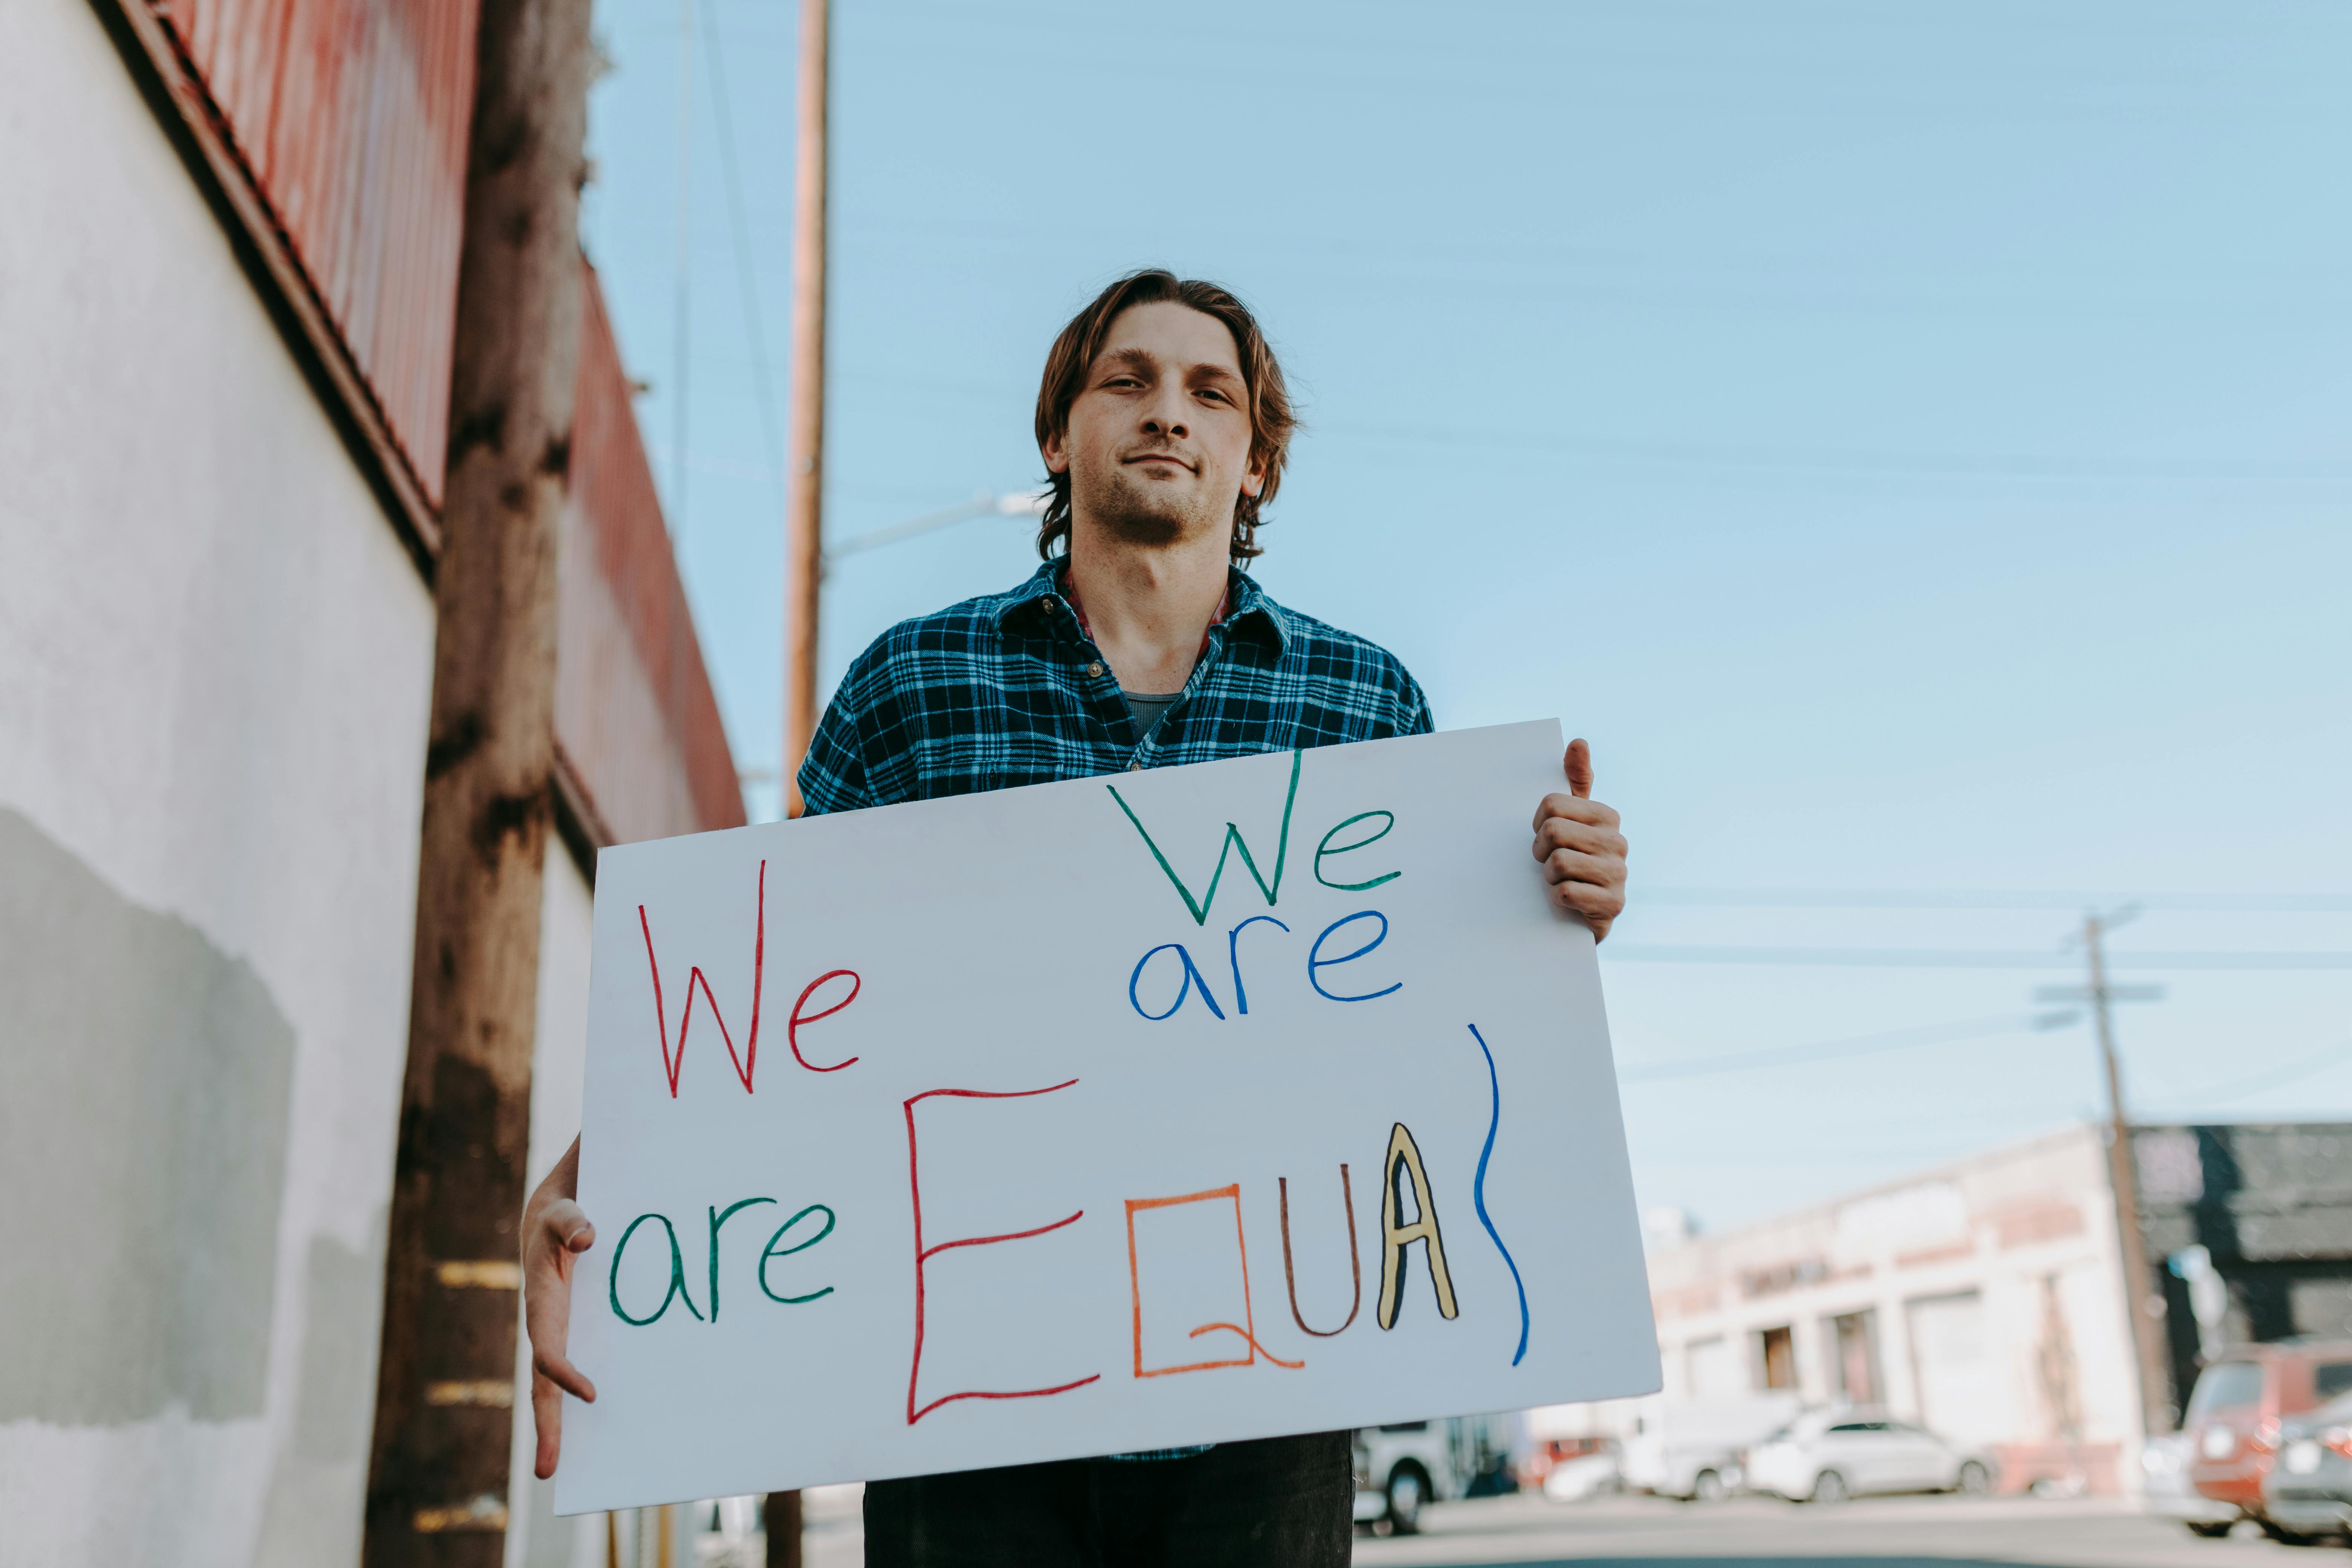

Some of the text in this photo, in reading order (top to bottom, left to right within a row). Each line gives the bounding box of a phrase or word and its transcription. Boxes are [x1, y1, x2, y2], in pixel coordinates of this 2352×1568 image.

[1107, 749, 1402, 927] We
[639, 859, 861, 1099] We
[1128, 910, 1403, 1021] are
[609, 1197, 836, 1327] are
